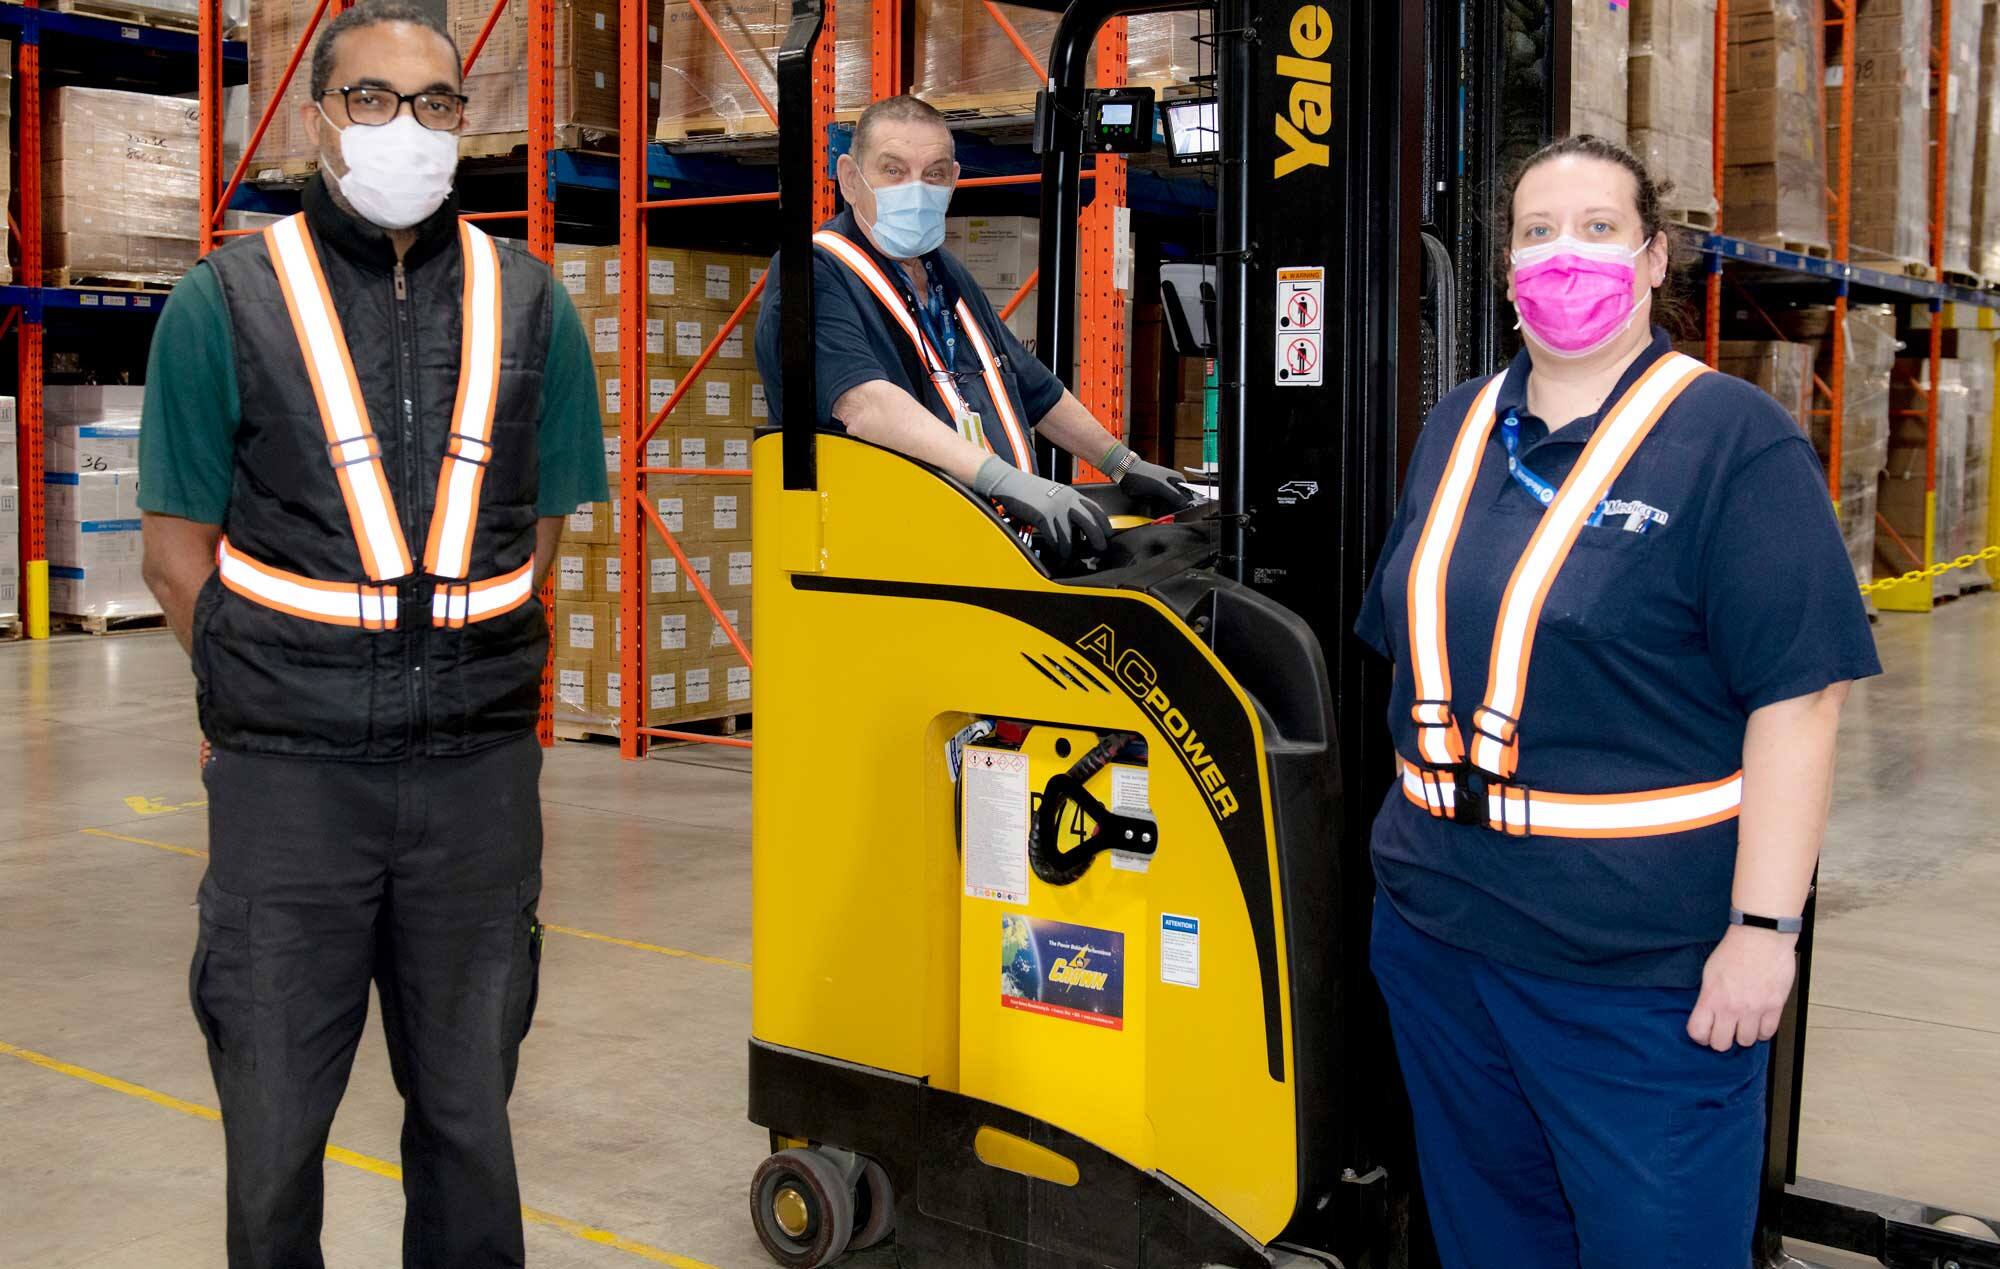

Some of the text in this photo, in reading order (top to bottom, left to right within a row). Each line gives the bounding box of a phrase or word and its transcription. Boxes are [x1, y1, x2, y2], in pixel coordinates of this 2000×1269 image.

[1274, 4, 1333, 180] Yale
[1289, 271, 1320, 279] WARNING
[81, 453, 107, 471] 36
[1075, 623, 1240, 819] AC POWER
[1165, 919, 1193, 929] ATTENTION
